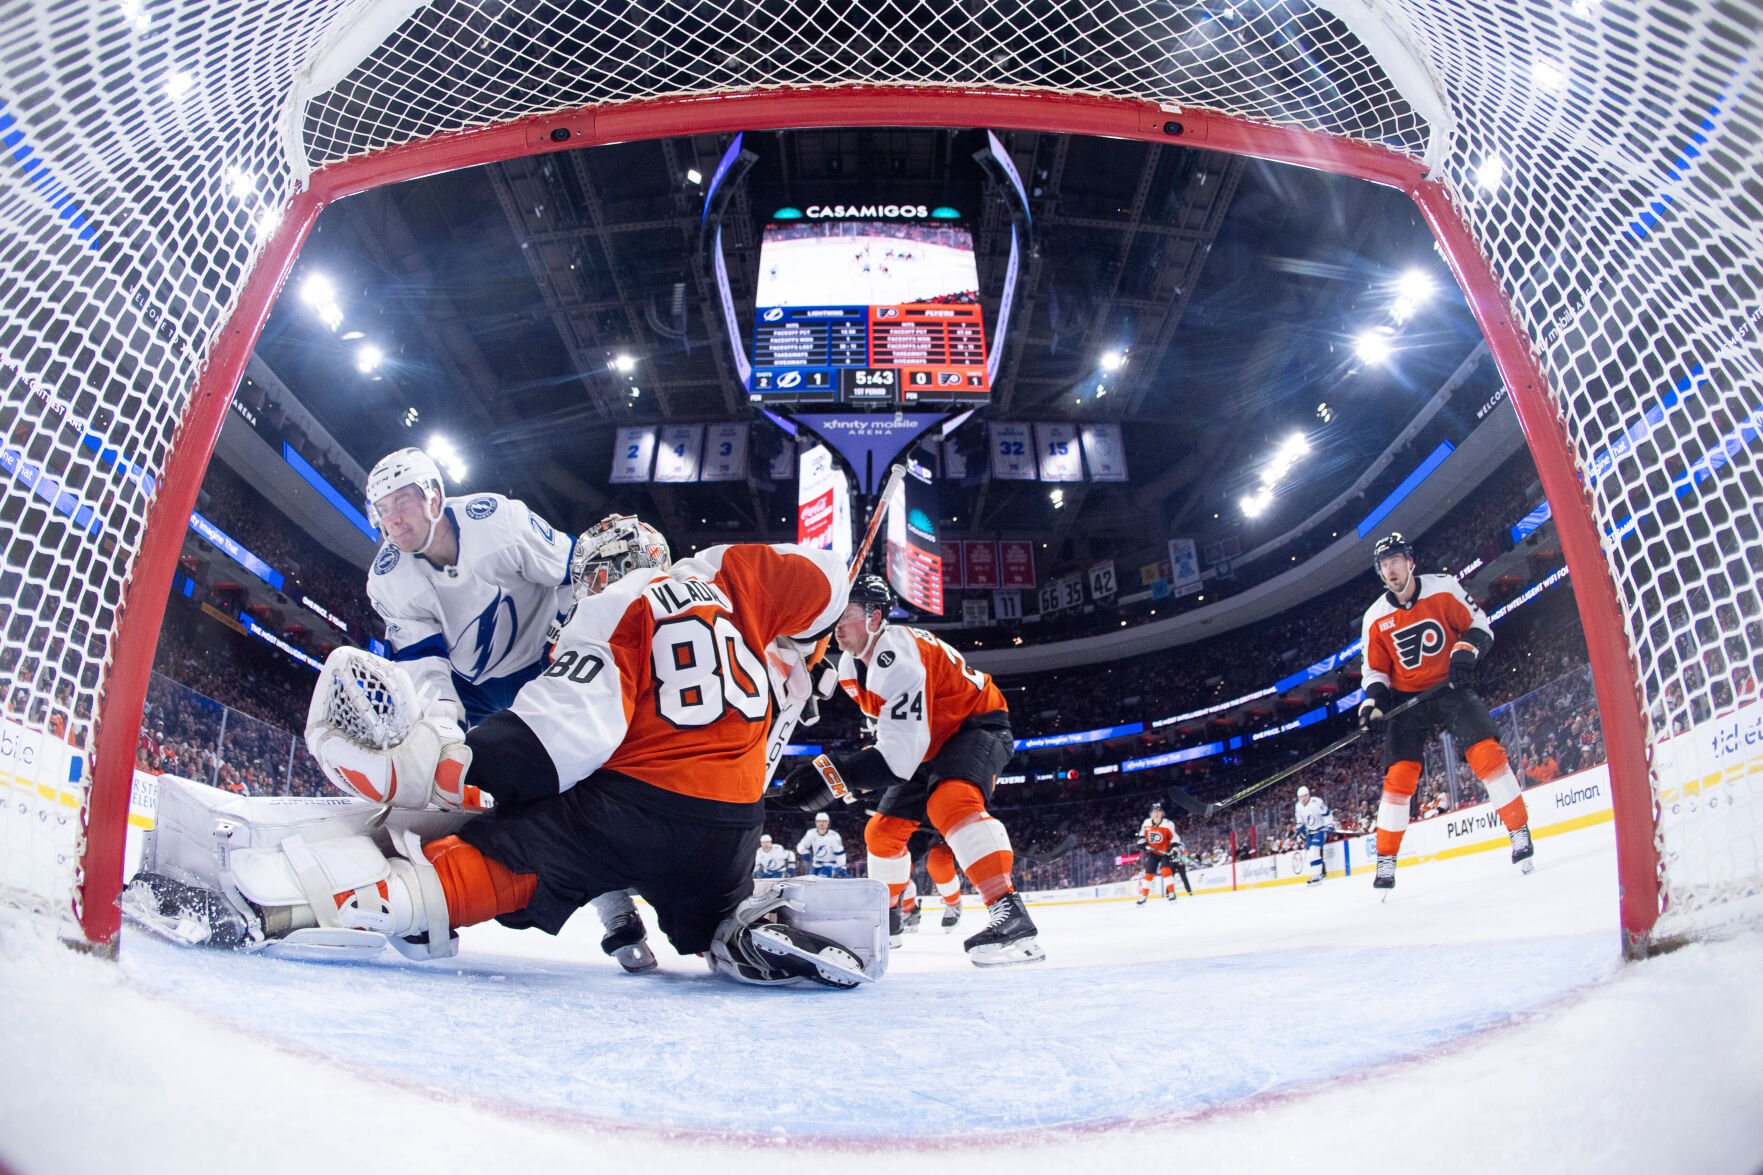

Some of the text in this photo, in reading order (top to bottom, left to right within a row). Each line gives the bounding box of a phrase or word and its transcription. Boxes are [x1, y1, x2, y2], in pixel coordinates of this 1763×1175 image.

[806, 205, 928, 218] CASAMIGOS
[760, 378, 768, 387] 2
[814, 373, 822, 385] 1
[856, 371, 894, 385] 5:43
[916, 372, 926, 385] 0
[972, 377, 978, 386] 1
[1476, 386, 1507, 418] WELCOM
[232, 398, 257, 427] ARENA
[823, 420, 918, 430] xfinity mobile
[627, 445, 640, 459] 2
[674, 444, 686, 458] 4
[720, 442, 732, 456] 3
[1000, 442, 1024, 456] 32
[1048, 442, 1068, 456] 15
[1094, 570, 1113, 594] 42
[651, 580, 728, 614] VLADA
[1042, 588, 1059, 611] 66
[1066, 581, 1081, 604] 35
[1506, 582, 1543, 612] INTELLIGENT
[1001, 596, 1014, 616] 11
[544, 650, 605, 683] 80
[650, 612, 771, 730] 80
[891, 690, 922, 720] 24
[815, 756, 846, 796] CCM
[996, 775, 1025, 784] FLYERS
[1556, 784, 1600, 808] Holman
[1447, 812, 1504, 838] PLAY TO WI
